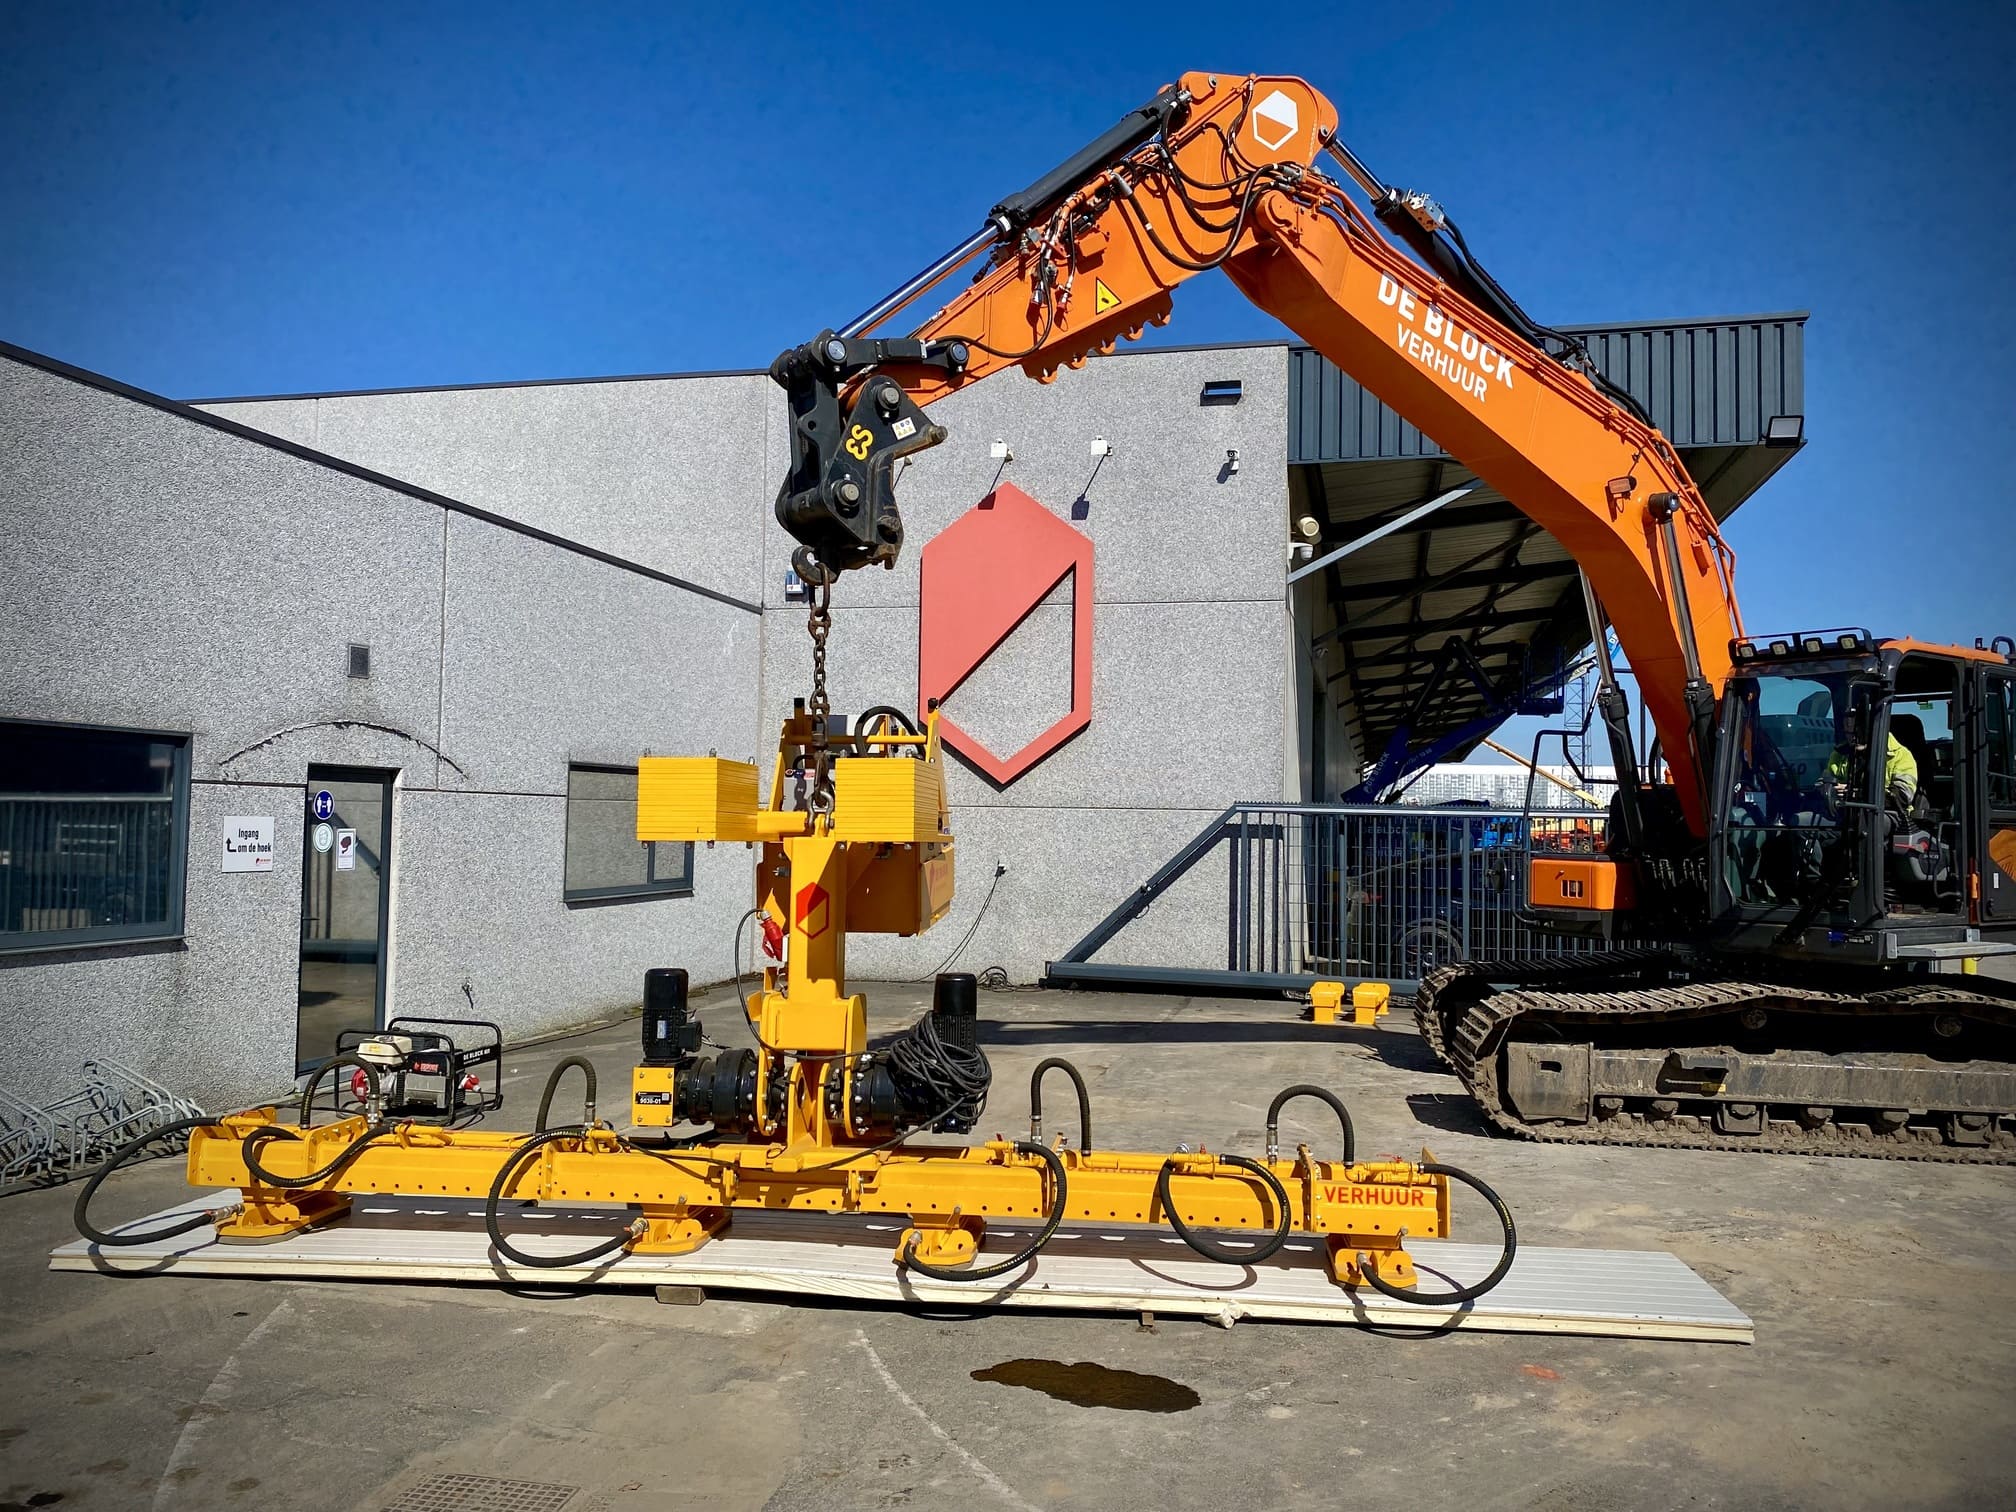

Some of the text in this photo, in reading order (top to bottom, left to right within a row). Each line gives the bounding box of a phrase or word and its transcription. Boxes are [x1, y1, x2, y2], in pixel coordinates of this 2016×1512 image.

[1378, 271, 1517, 389] DE BLOCK
[1397, 323, 1488, 403] VERHUUR
[238, 828, 259, 840] Ingang
[237, 842, 271, 853] om de hoek
[1324, 1186, 1424, 1206] VERHUUR
